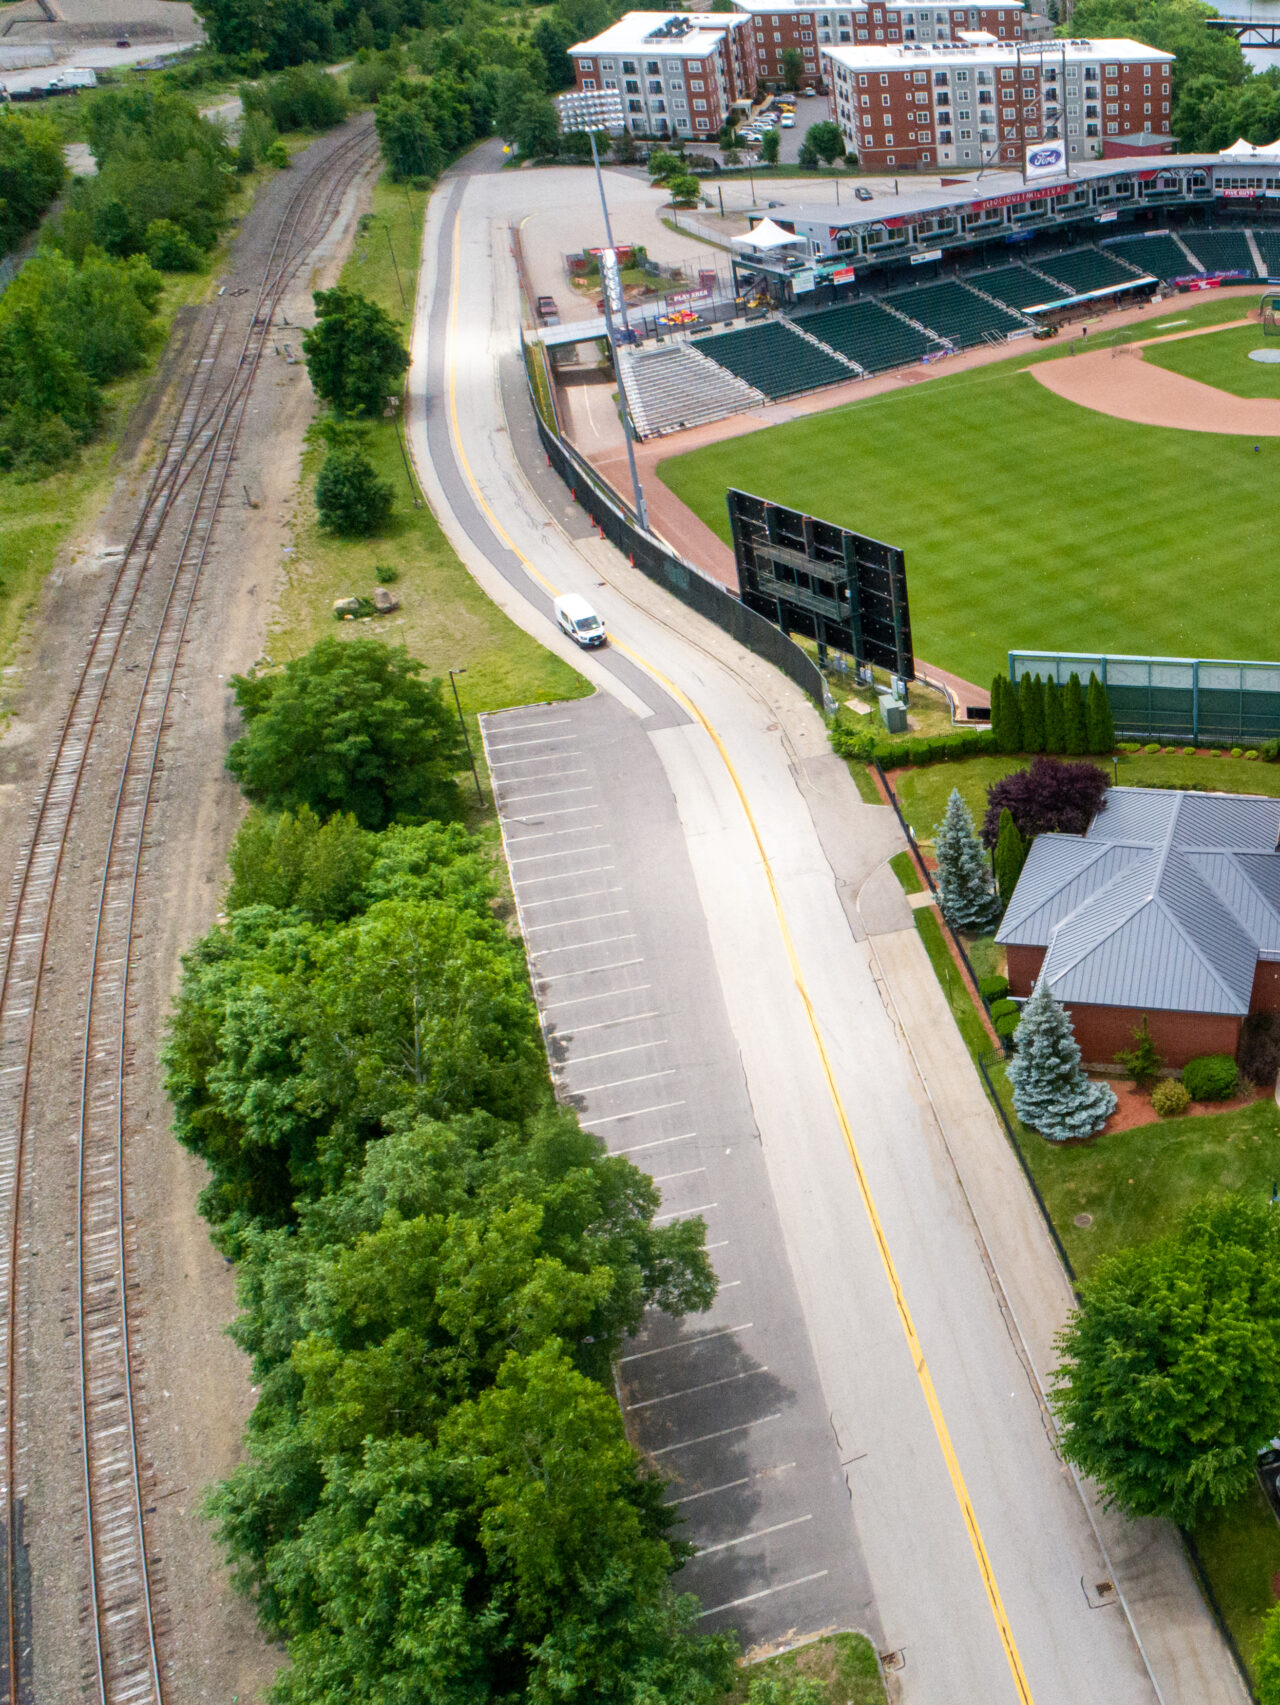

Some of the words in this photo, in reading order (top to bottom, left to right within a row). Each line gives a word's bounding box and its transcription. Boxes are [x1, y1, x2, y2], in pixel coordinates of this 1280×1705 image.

[1034, 151, 1056, 166] Ford
[674, 293, 690, 302] PLAY
[691, 289, 708, 298] AREA
